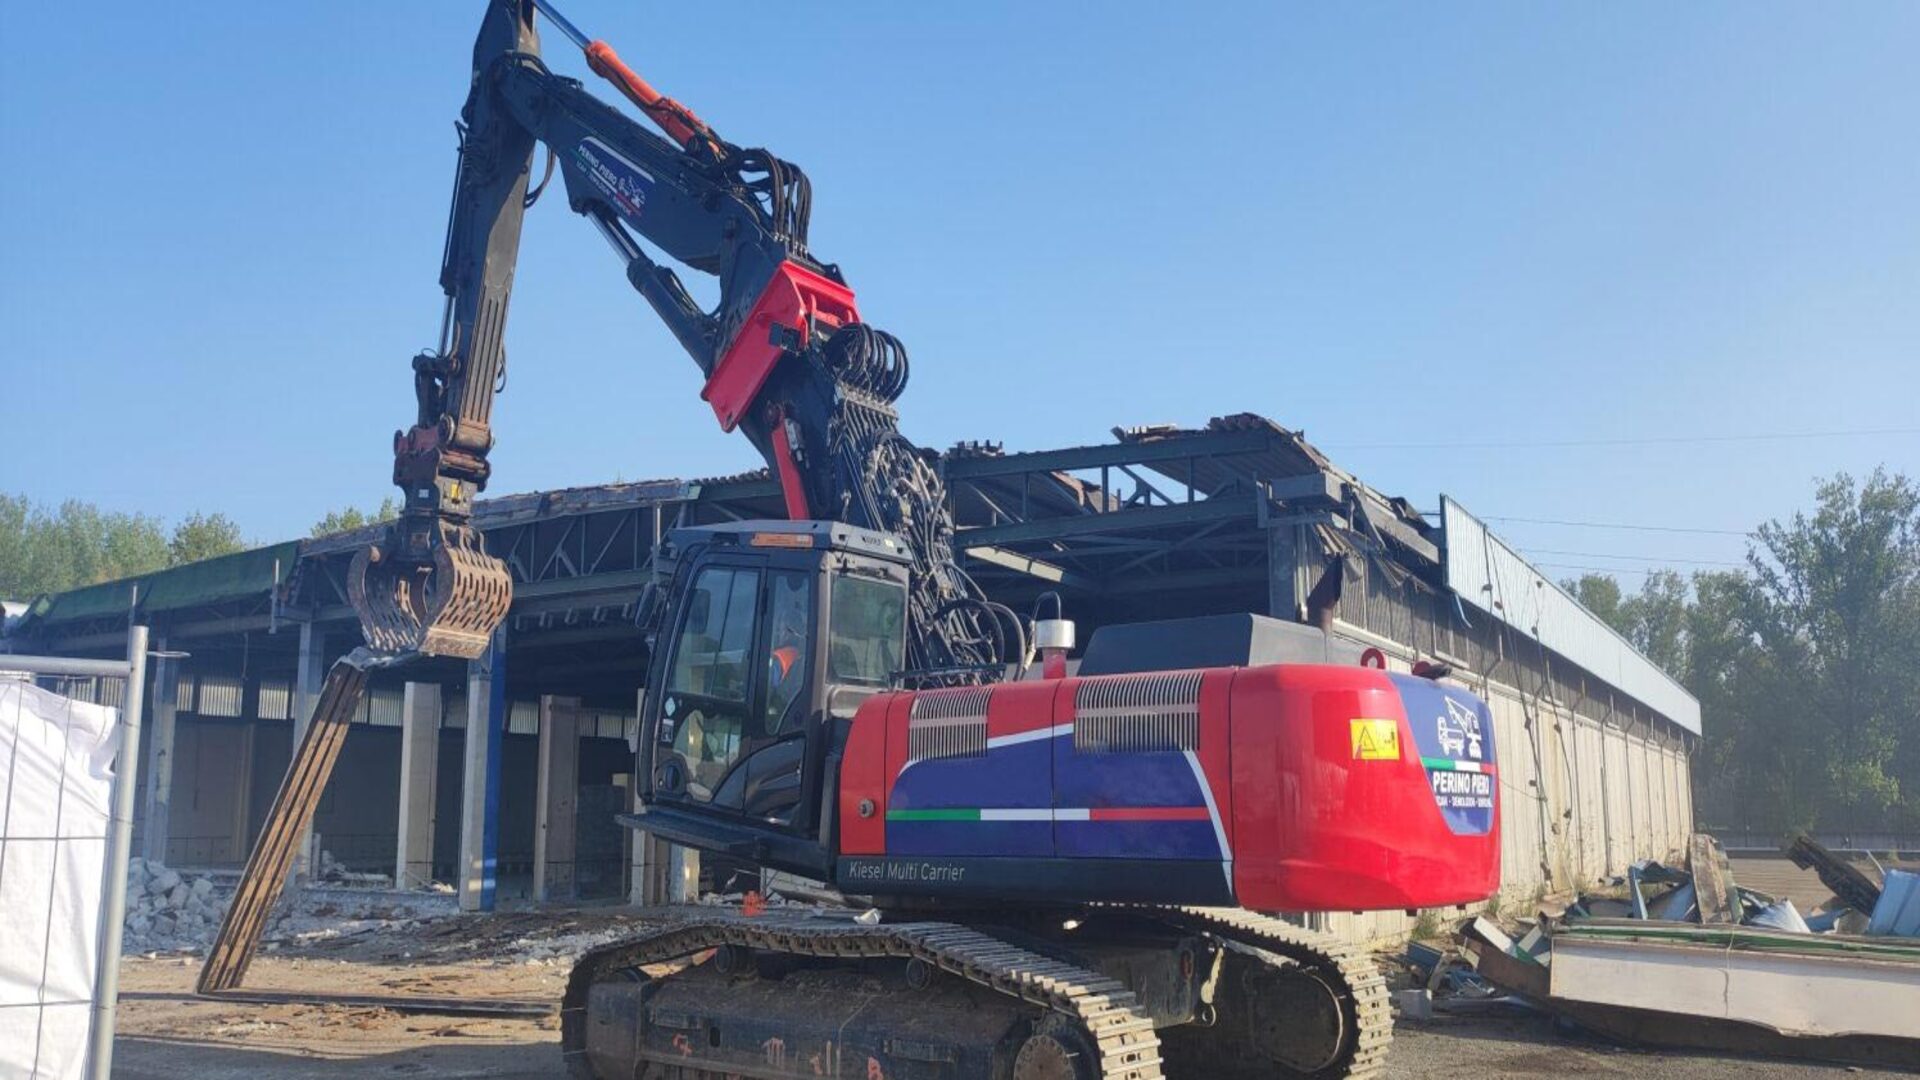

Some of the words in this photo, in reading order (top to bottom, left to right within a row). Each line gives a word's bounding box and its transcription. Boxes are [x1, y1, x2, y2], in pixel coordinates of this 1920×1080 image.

[1433, 770, 1471, 794] PERINO
[849, 861, 885, 879] Kiesel
[887, 861, 918, 880] Multi
[920, 862, 965, 881] Carrier
